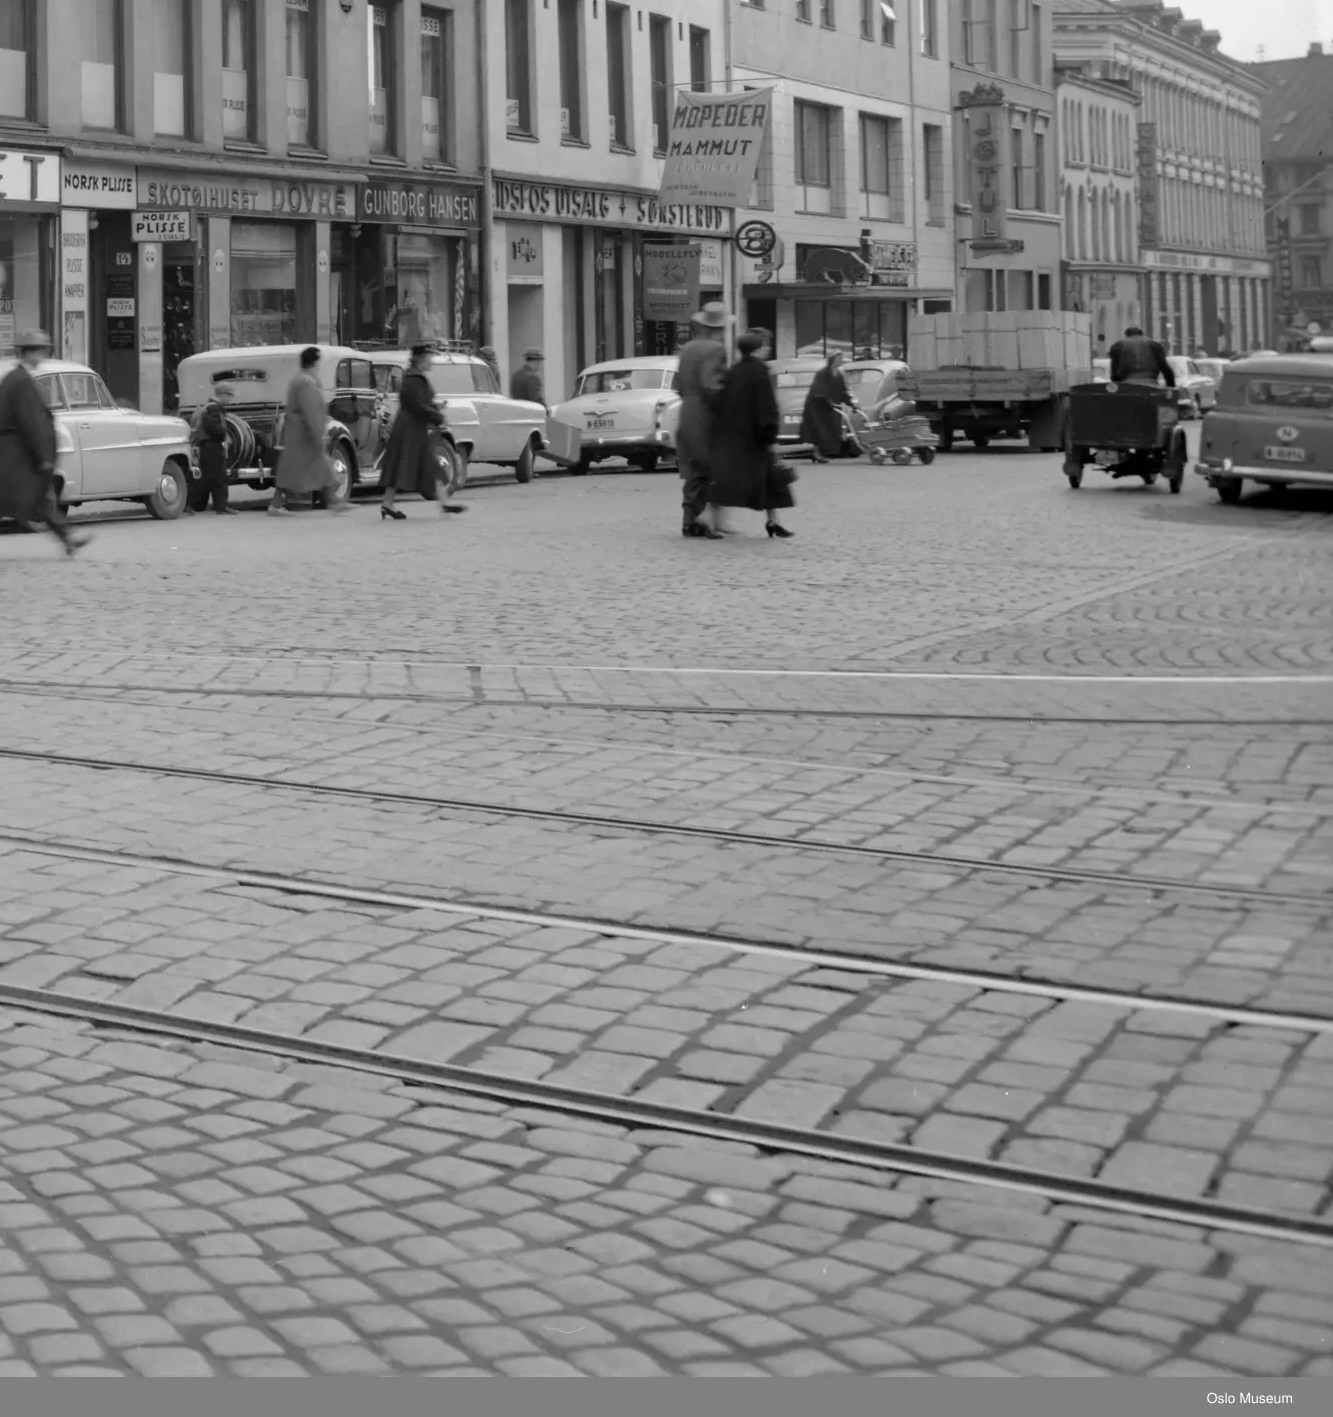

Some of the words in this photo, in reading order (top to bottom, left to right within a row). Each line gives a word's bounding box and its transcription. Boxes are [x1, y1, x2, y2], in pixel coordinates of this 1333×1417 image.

[673, 104, 766, 129] MOPEDER
[670, 139, 752, 157] MAMMUT
[64, 174, 99, 191] NORSK
[101, 176, 132, 193] PLISSE
[364, 188, 425, 218] GUNBORG
[429, 193, 477, 221] HANSEN
[494, 181, 550, 214] IDSFOS
[142, 213, 180, 222] NORSK
[136, 221, 186, 234] PLISSE
